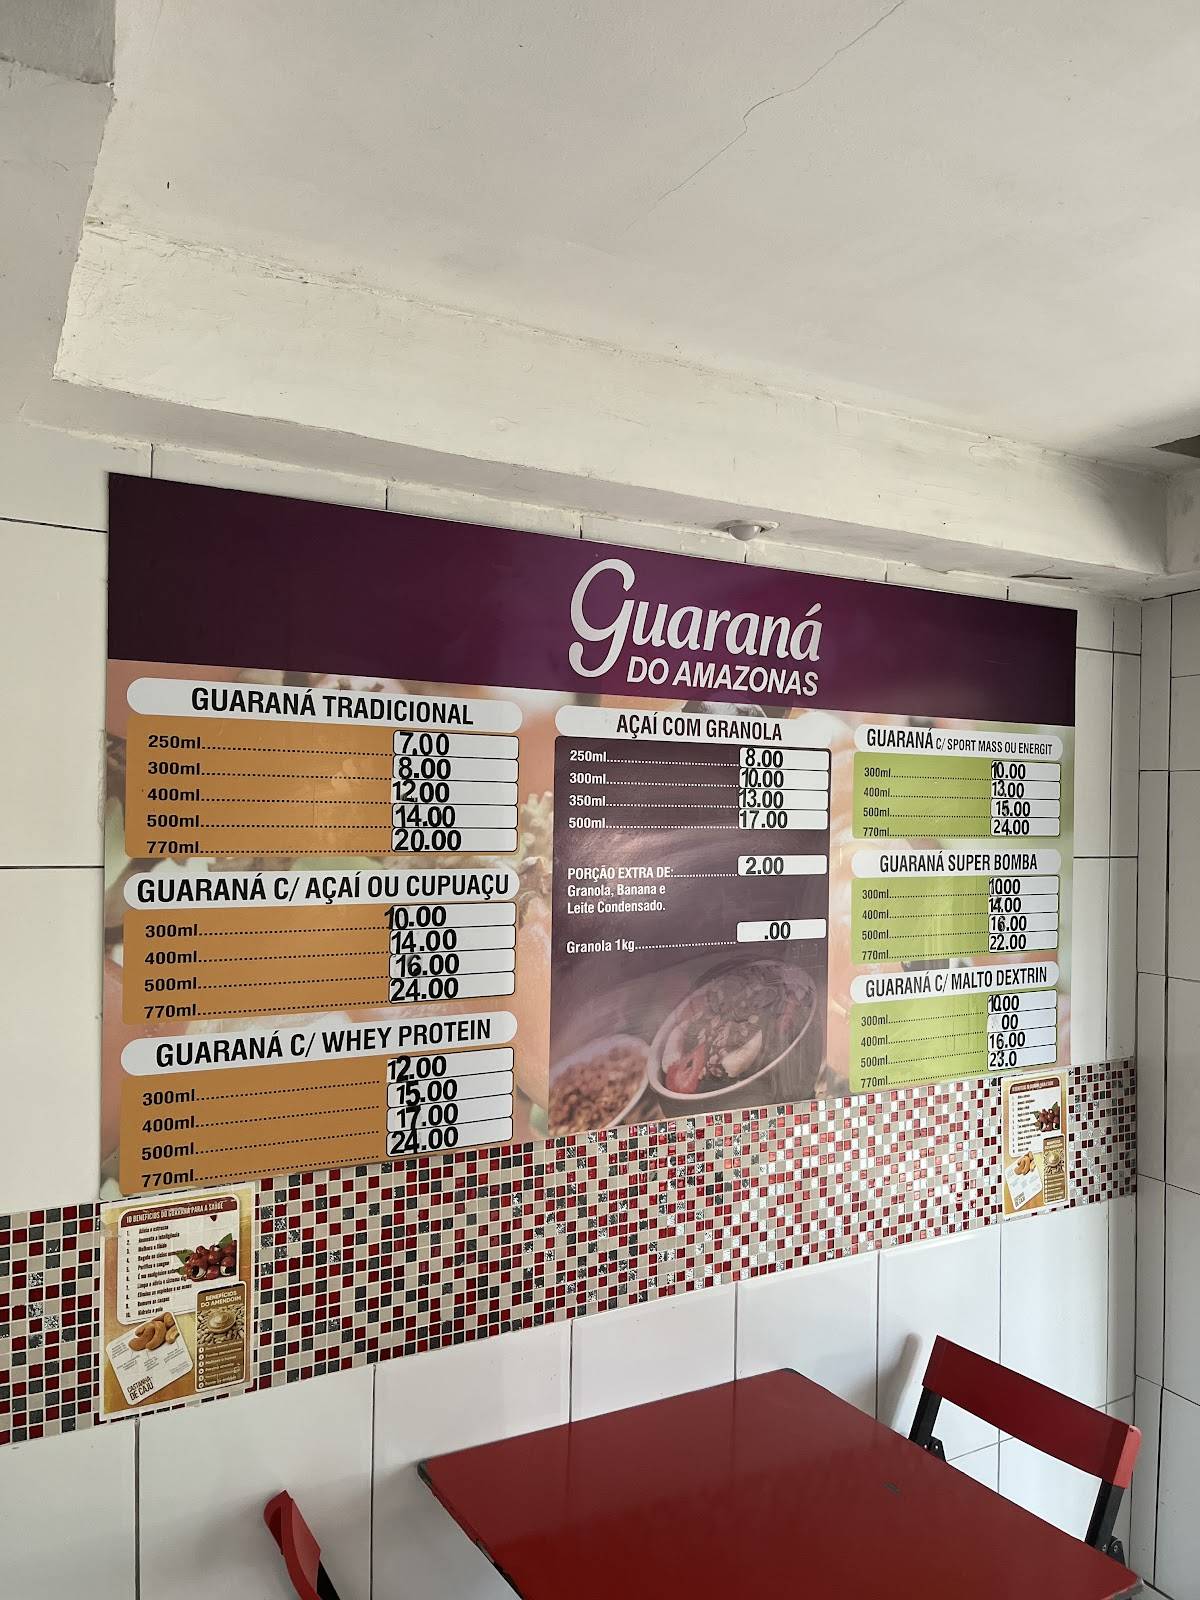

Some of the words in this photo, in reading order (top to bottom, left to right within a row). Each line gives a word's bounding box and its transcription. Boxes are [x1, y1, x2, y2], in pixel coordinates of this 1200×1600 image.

[568, 558, 823, 678] Guaraná
[626, 655, 669, 684] DO
[672, 660, 820, 697] AMAZONAS
[191, 687, 316, 716] GUARANÁ
[322, 695, 474, 725] TRADICIONAL
[616, 712, 658, 738] AÇAÍ
[662, 716, 700, 737] COM
[706, 720, 783, 741] GRANOLA
[148, 735, 201, 749] 250ml
[866, 727, 933, 750] GUARANÁ
[935, 737, 946, 750] C/
[947, 738, 977, 751] SPORT
[978, 740, 1003, 753] MASS
[1004, 742, 1017, 753] OU
[1018, 742, 1053, 756] ENERGIT
[147, 761, 200, 775] 300ml
[398, 756, 451, 780] 8.00
[570, 750, 607, 763] 250ml
[744, 748, 784, 768] 8.00
[864, 767, 891, 778] 300ml
[991, 761, 1026, 779] 10.00
[569, 773, 606, 785] 300ml
[741, 767, 784, 789] 10.00
[147, 788, 200, 801] 400ml
[569, 795, 606, 807] 350ml
[738, 788, 784, 809] 13.00
[863, 787, 890, 797] 400ml
[146, 814, 200, 828] 500ml
[395, 805, 456, 828] 14.00
[568, 817, 606, 829] 500ml
[739, 810, 788, 829] 17.00
[863, 807, 890, 818] 500ml
[996, 800, 1031, 817] 15.00
[863, 826, 890, 837] 770ml
[993, 819, 1030, 836] 24.00
[146, 841, 199, 854] 770ml
[394, 828, 462, 851] 20.00
[567, 865, 615, 884] PORÇÃO
[618, 867, 655, 879] EXTRA
[745, 856, 784, 875] 2.00
[879, 850, 945, 873] GUARANÁ
[948, 854, 990, 871] SUPER
[994, 853, 1038, 870] BOMBA
[137, 872, 267, 903] GUARANÁ
[274, 877, 300, 902] C/
[305, 871, 362, 904] AÇAÍ
[367, 875, 399, 898] OU
[406, 874, 509, 900] CUPUAÇU
[567, 885, 614, 897] Granola,
[617, 884, 656, 896] Banana
[659, 885, 666, 894] e
[862, 889, 889, 900] 300ml
[567, 902, 594, 915] Leite
[597, 899, 666, 914] Condensado.
[862, 909, 889, 920] 400ml
[989, 897, 1021, 913] 14.00
[145, 924, 198, 938] 300ml
[384, 906, 447, 930] 10.00
[861, 929, 889, 940] 500ml
[991, 915, 1027, 932] 16.00
[144, 950, 197, 965] 400ml
[391, 929, 457, 954] 14.00
[567, 941, 612, 954] Granola
[615, 939, 635, 952] 1kg
[861, 949, 889, 960] 770ml
[989, 934, 1027, 950] 22.00
[144, 977, 197, 992] 500ml
[395, 953, 460, 977] 16.00
[865, 971, 931, 998] GUARANÁ
[934, 974, 949, 993] C/
[951, 970, 993, 990] MALTO
[996, 966, 1047, 986] DEXTRIN
[143, 1004, 196, 1019] 770ml
[390, 977, 459, 1001] 24.00
[860, 1034, 888, 1047] 400ml
[1001, 1014, 1018, 1030] 00
[861, 1014, 888, 1027] 300ml
[156, 1030, 283, 1067] GUARANÁ
[290, 1033, 316, 1058] C/
[322, 1027, 392, 1053] WHEY
[398, 1018, 491, 1047] PROTEIN
[860, 1055, 888, 1068] 500ml
[989, 1031, 1026, 1049] 16.00
[142, 1089, 195, 1106] 300ml
[387, 1055, 447, 1083] 12.00
[860, 1075, 888, 1089] 770ml
[989, 1050, 1017, 1067] 23.0
[142, 1116, 195, 1133] 400ml
[396, 1079, 458, 1106] 15.00
[141, 1142, 194, 1161] 500ml
[396, 1102, 459, 1130] 17.00
[141, 1169, 194, 1188] 770ml
[390, 1126, 459, 1154] 24.00
[211, 1295, 242, 1306] AMENDOIM
[129, 1390, 139, 1401] DE
